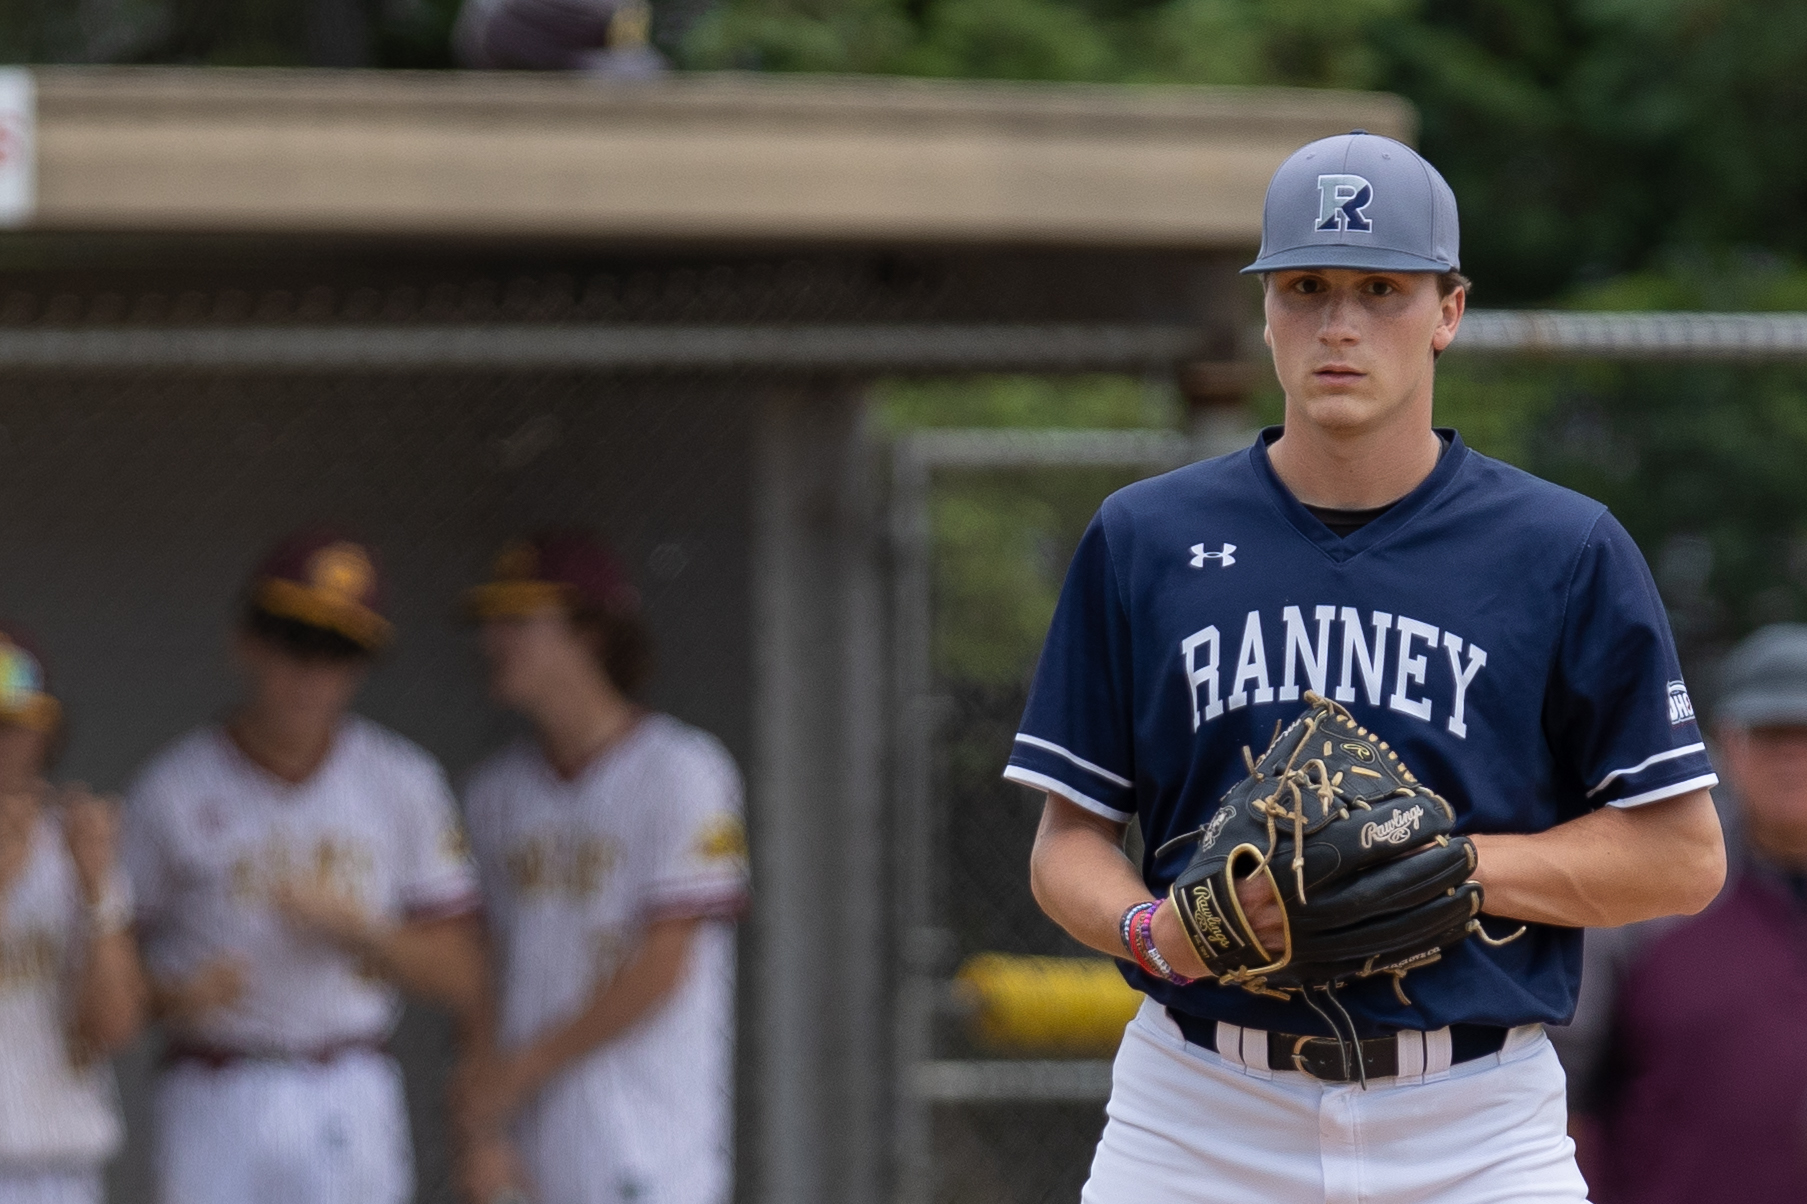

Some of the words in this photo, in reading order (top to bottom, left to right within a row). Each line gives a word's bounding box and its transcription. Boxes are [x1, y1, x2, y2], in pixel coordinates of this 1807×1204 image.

[1315, 174, 1374, 233] R
[1181, 605, 1488, 739] RANNEY
[1361, 804, 1424, 849] Rawlings
[1193, 886, 1230, 949] Rawlings
